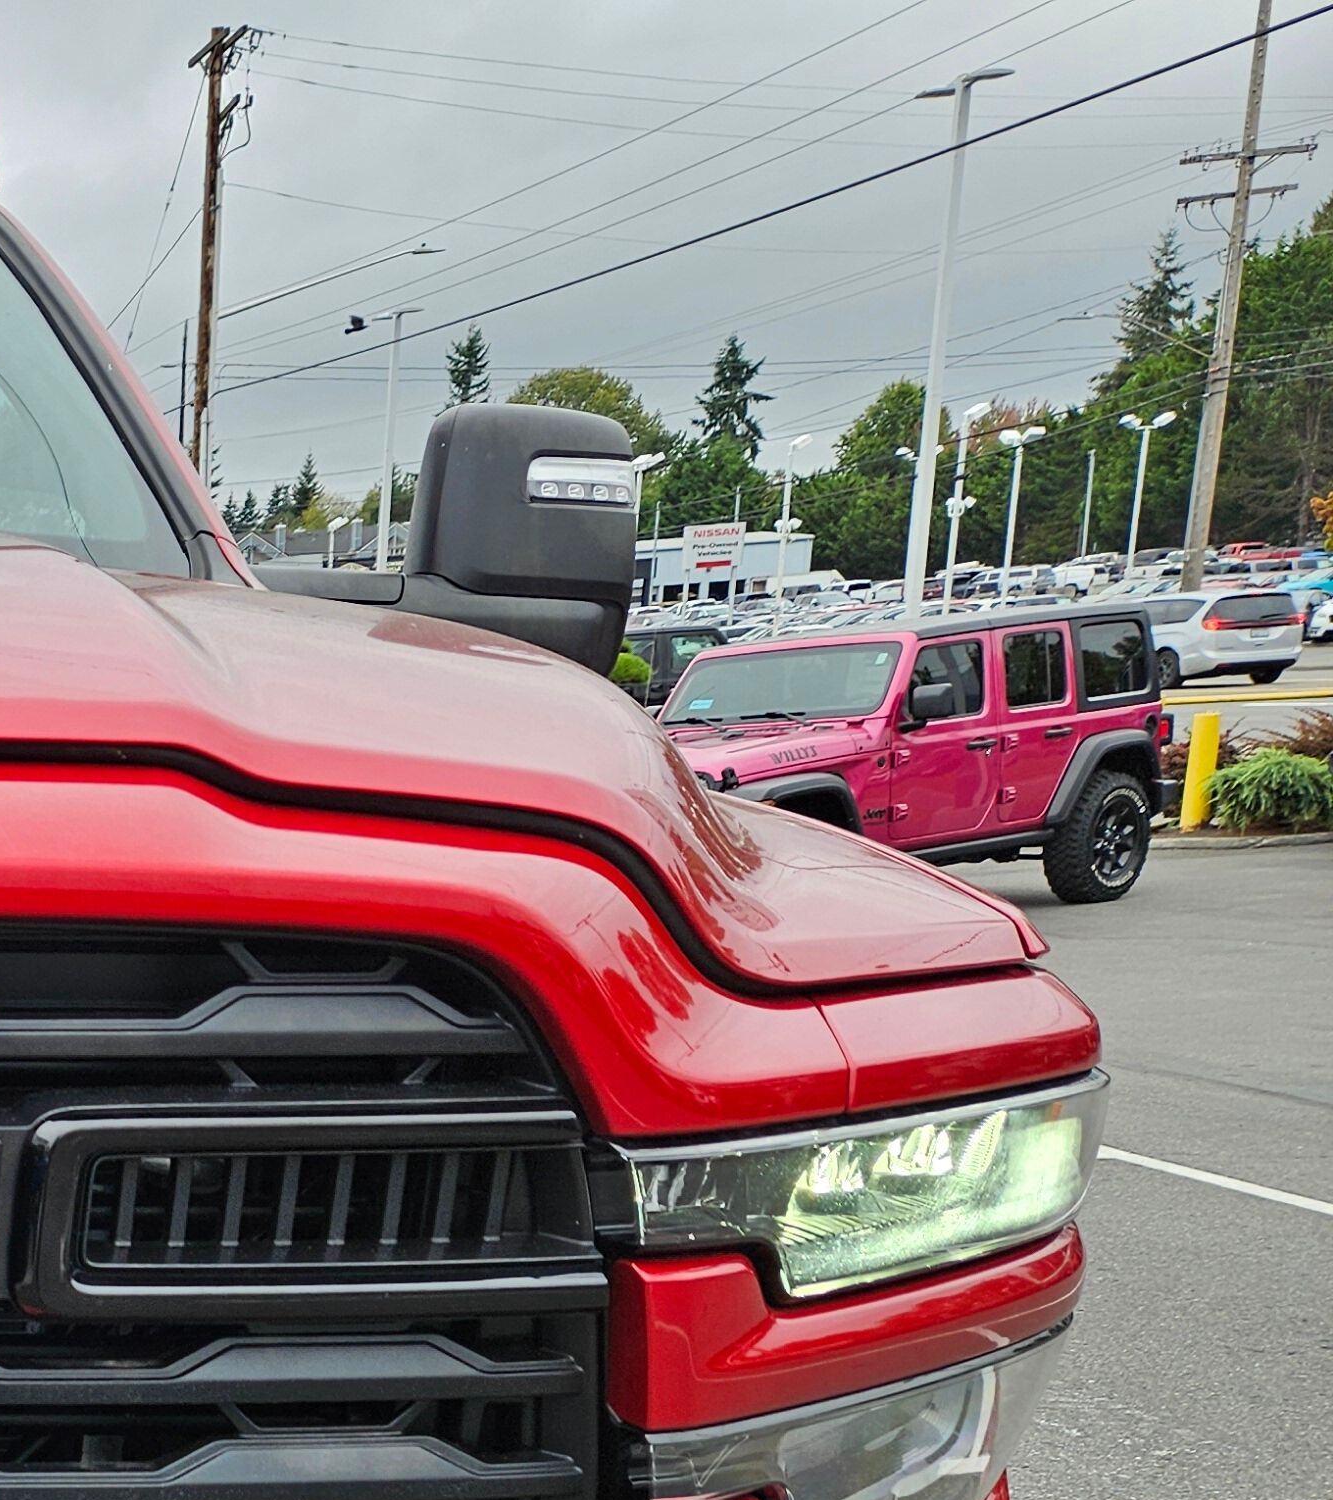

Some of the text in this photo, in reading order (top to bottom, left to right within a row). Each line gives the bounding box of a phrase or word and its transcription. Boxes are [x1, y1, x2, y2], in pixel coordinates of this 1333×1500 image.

[693, 527, 740, 538] NISSAN
[693, 541, 738, 549] Pre-Owned
[769, 745, 817, 764] WILLYS
